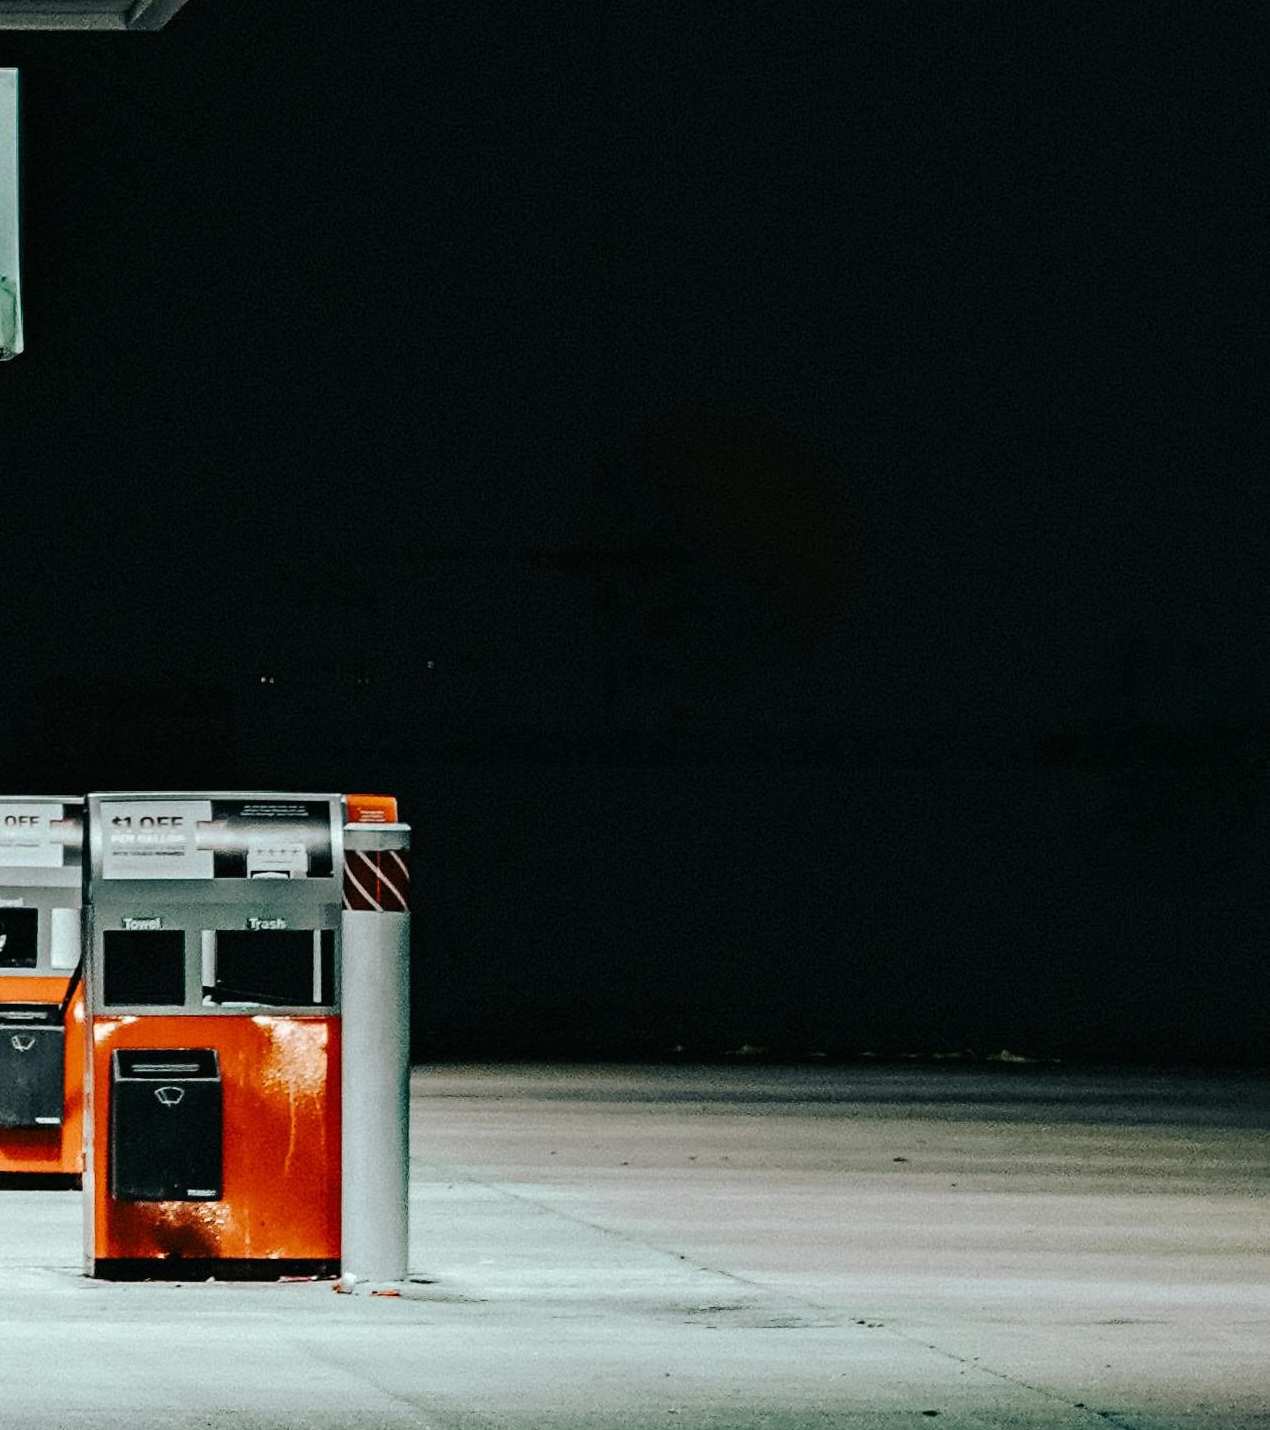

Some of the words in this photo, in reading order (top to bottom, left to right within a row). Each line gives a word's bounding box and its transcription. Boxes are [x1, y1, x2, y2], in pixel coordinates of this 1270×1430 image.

[4, 815, 40, 826] OFF
[140, 816, 184, 829] OFF
[123, 917, 161, 930] Towel
[248, 917, 287, 930] Trash
